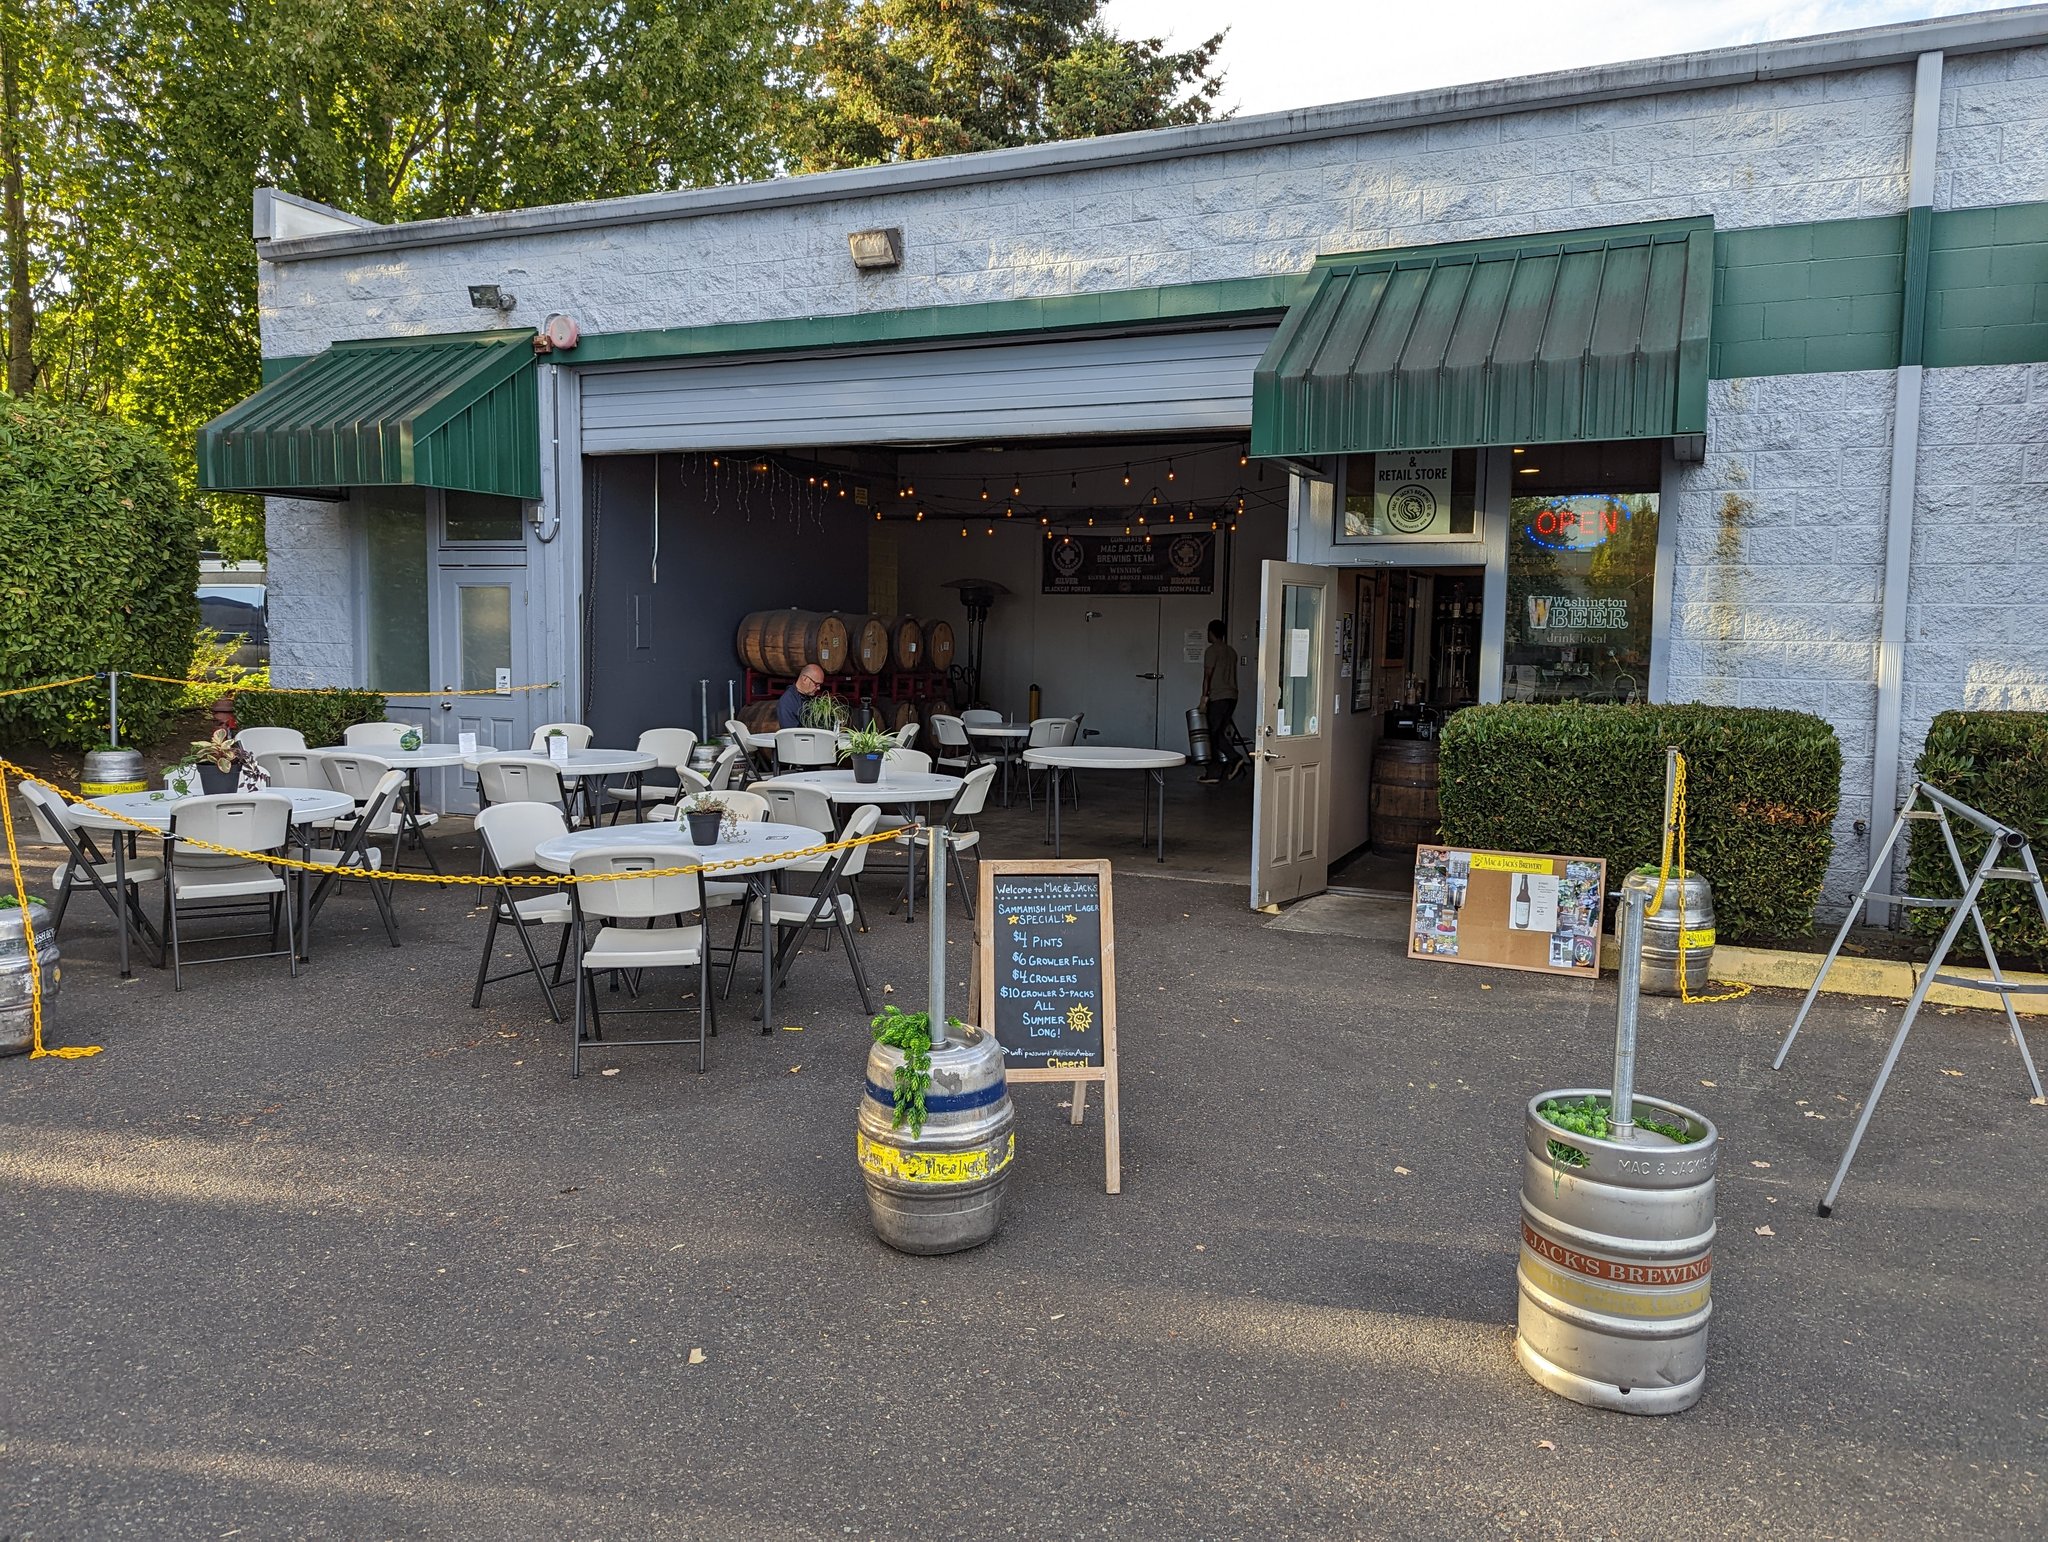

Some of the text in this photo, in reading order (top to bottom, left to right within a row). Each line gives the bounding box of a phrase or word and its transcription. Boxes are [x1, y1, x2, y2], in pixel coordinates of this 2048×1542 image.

[1409, 456, 1416, 468] &
[1379, 468, 1447, 481] RETAIL STORE
[1536, 510, 1618, 535] OPEN
[1100, 544, 1117, 552] MAC
[1125, 544, 1152, 552] JACK'S
[1096, 554, 1155, 563] BREWING TEAM
[1552, 596, 1628, 609] Washington
[1550, 608, 1628, 629] BEER
[1546, 632, 1607, 644] drink local
[1484, 857, 1496, 866] MAC
[1502, 859, 1518, 868] JACK'S
[1519, 861, 1543, 870] BREWERY
[996, 884, 1032, 894] Welcome
[1044, 883, 1062, 893] MAC
[1063, 883, 1071, 892] &
[1072, 882, 1098, 892] JACK'S
[998, 903, 1046, 914] SAMMAMISH
[1049, 903, 1072, 912] LIGHT
[1019, 914, 1064, 925] SPECIAL!
[1013, 930, 1063, 948] $4 PINTS
[1012, 951, 1094, 966] $6 GROWLER FILLS
[1012, 969, 1078, 983] $4 CROWLERS
[1000, 986, 1020, 998] $10
[1059, 988, 1094, 998] 3-PACKS
[1034, 1000, 1055, 1011] ALL
[1023, 1012, 1066, 1025] SUMMER
[1030, 1027, 1060, 1038] LONG!
[1047, 1057, 1088, 1068] Cheers!
[1618, 1157, 1707, 1175] MAC & JACK'S
[1530, 1234, 1600, 1275] JACK'S
[1608, 1258, 1707, 1284] BREWING
